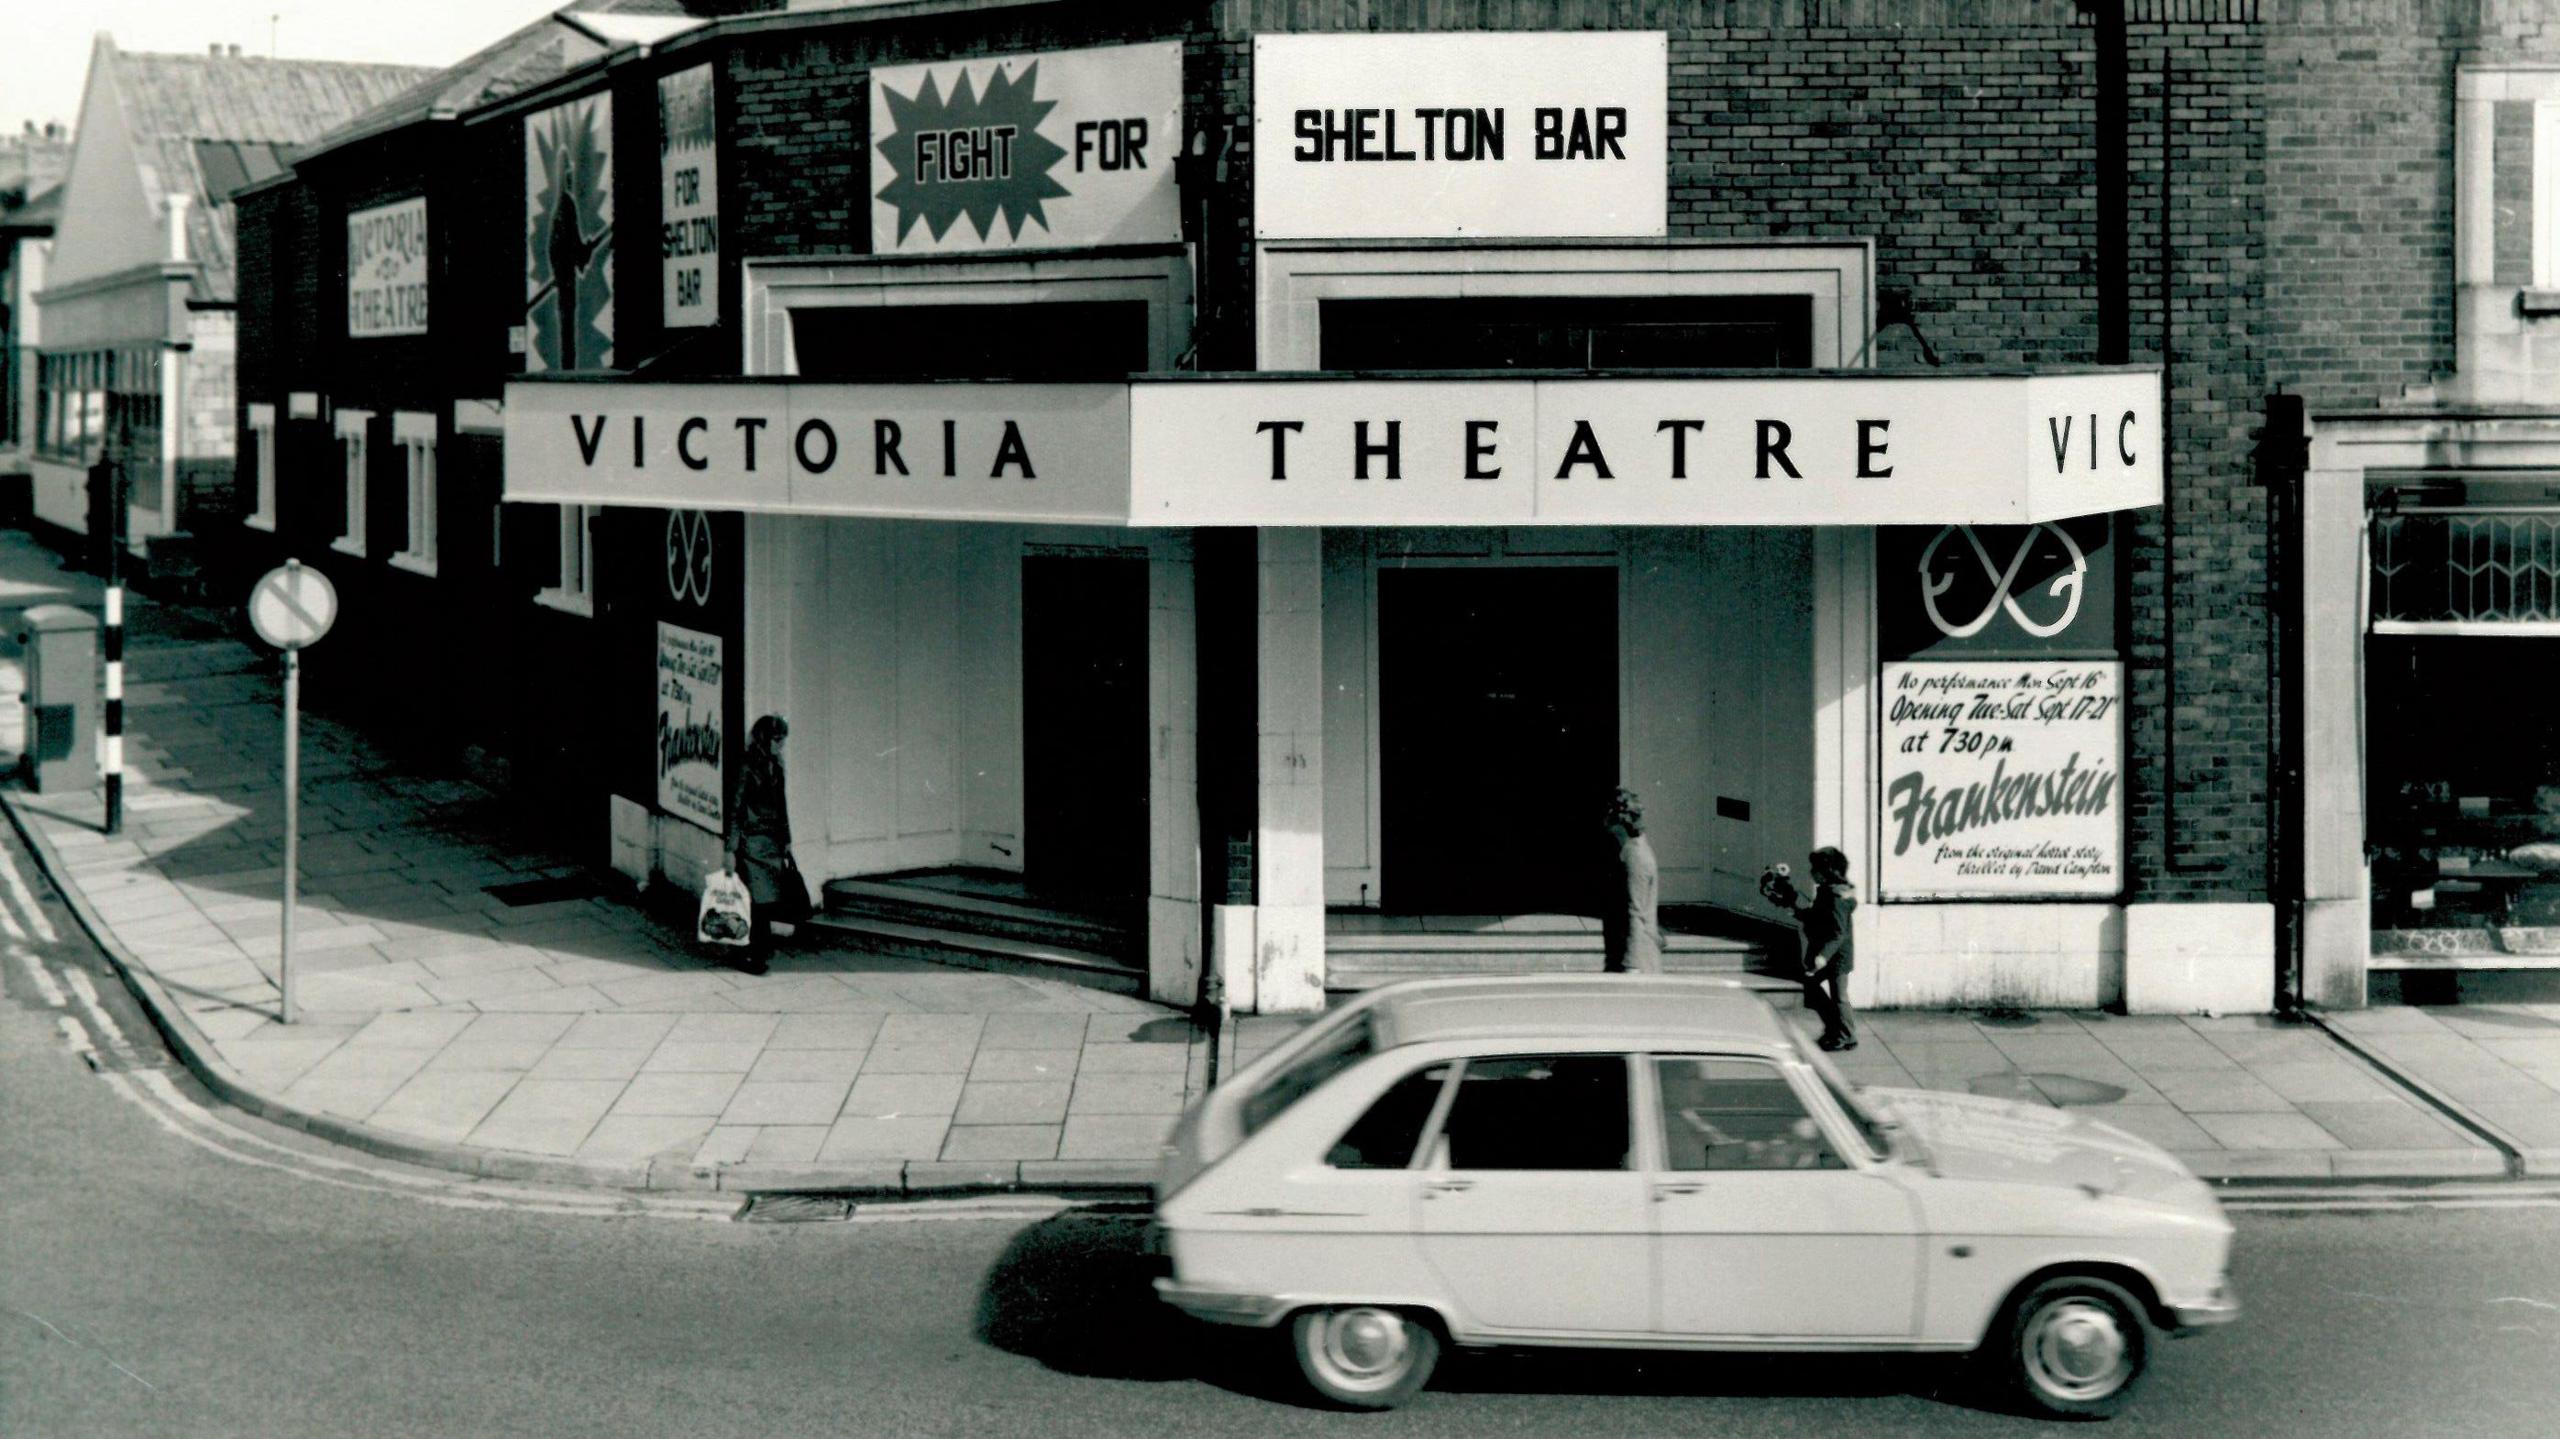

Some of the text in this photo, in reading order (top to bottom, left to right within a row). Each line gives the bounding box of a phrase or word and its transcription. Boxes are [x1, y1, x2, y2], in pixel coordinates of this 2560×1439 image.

[916, 117, 1148, 183] FIGHT FOR
[1294, 107, 1627, 161] SHELTON BAR
[674, 166, 700, 208] FOR
[662, 215, 719, 259] SHELTON
[352, 282, 428, 329] THEATRE
[676, 267, 702, 307] BAR
[570, 414, 1894, 481] VICTORIA THEATRE
[2048, 410, 2136, 474] VIC
[1897, 671, 1919, 690] No
[1918, 671, 2013, 696] performance
[2012, 673, 2042, 689] Mon
[2045, 669, 2081, 694] Sept
[1890, 694, 1965, 727] Opening
[2032, 694, 2073, 726] Sept
[1900, 730, 1929, 753] at
[1888, 751, 2118, 857] Frankenstein
[1933, 842, 1963, 864] from
[1965, 843, 1985, 859] the
